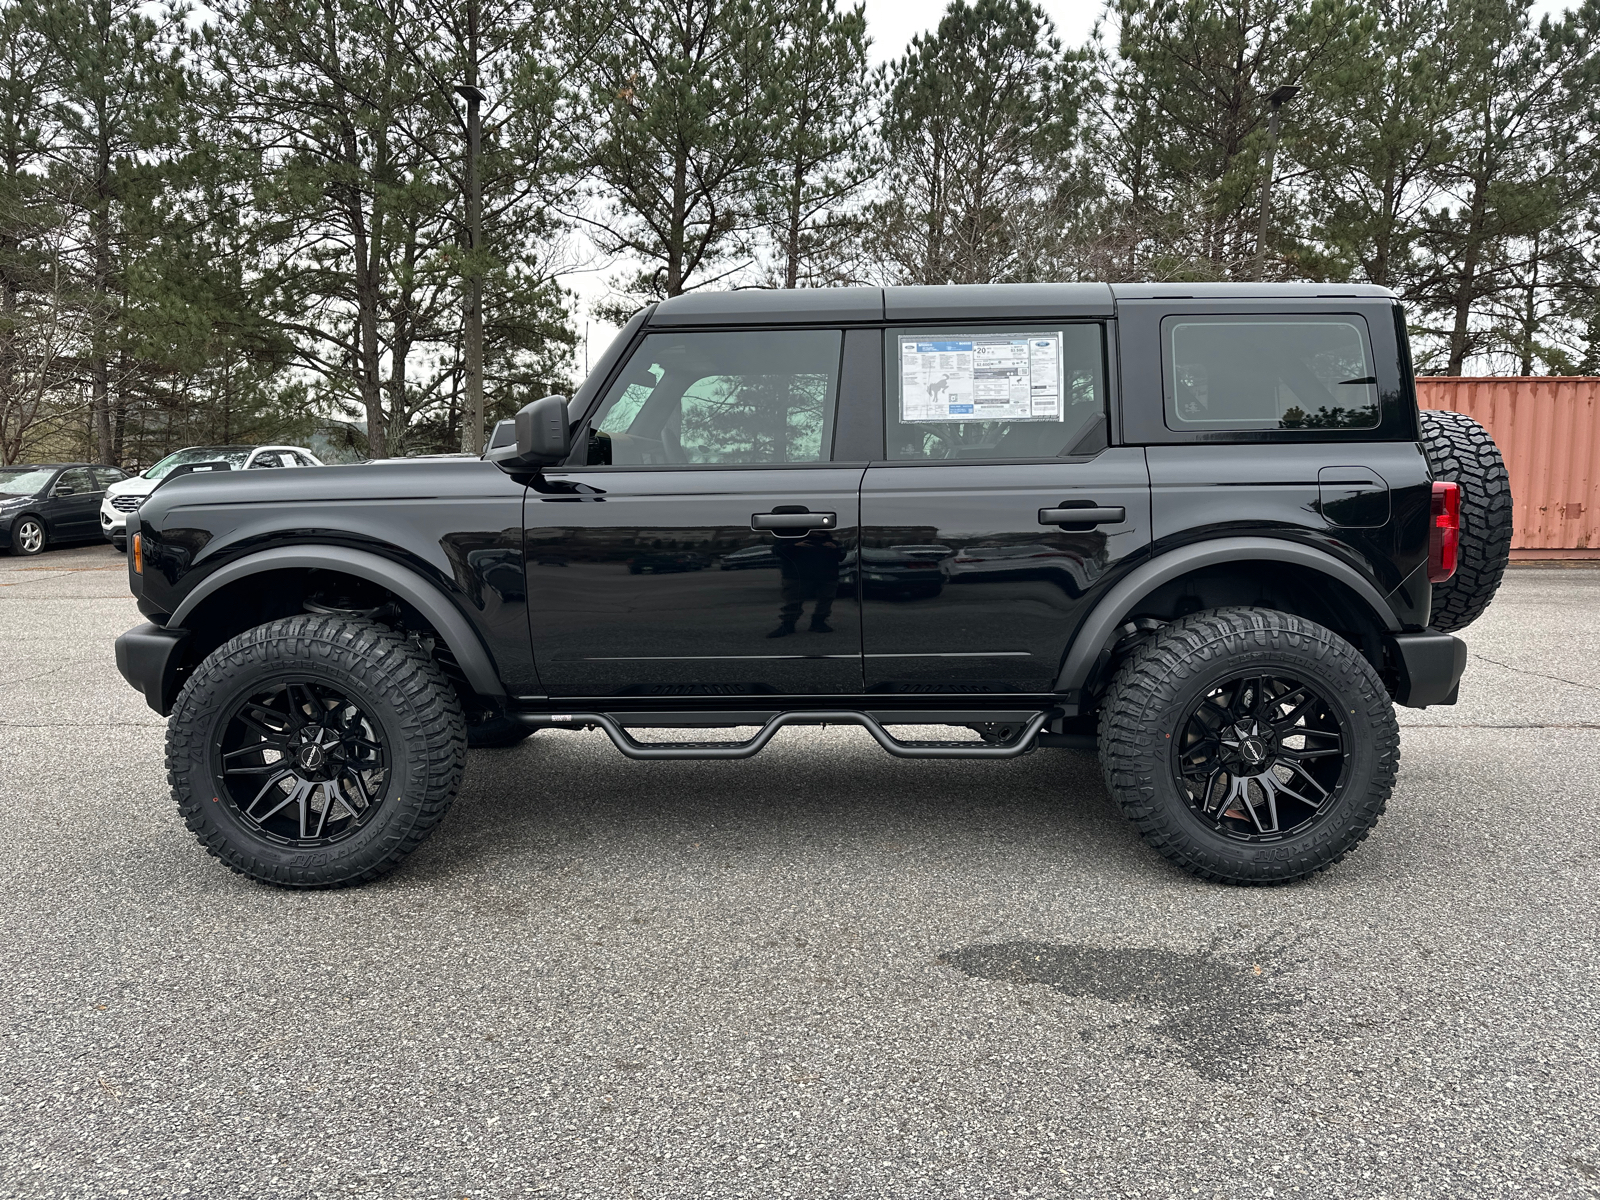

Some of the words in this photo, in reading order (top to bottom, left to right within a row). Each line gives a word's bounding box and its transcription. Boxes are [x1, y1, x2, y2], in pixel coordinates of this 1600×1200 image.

[1292, 798, 1360, 855] TRAILTEK
[289, 853, 327, 868] R/T
[1253, 846, 1291, 863] R/T
